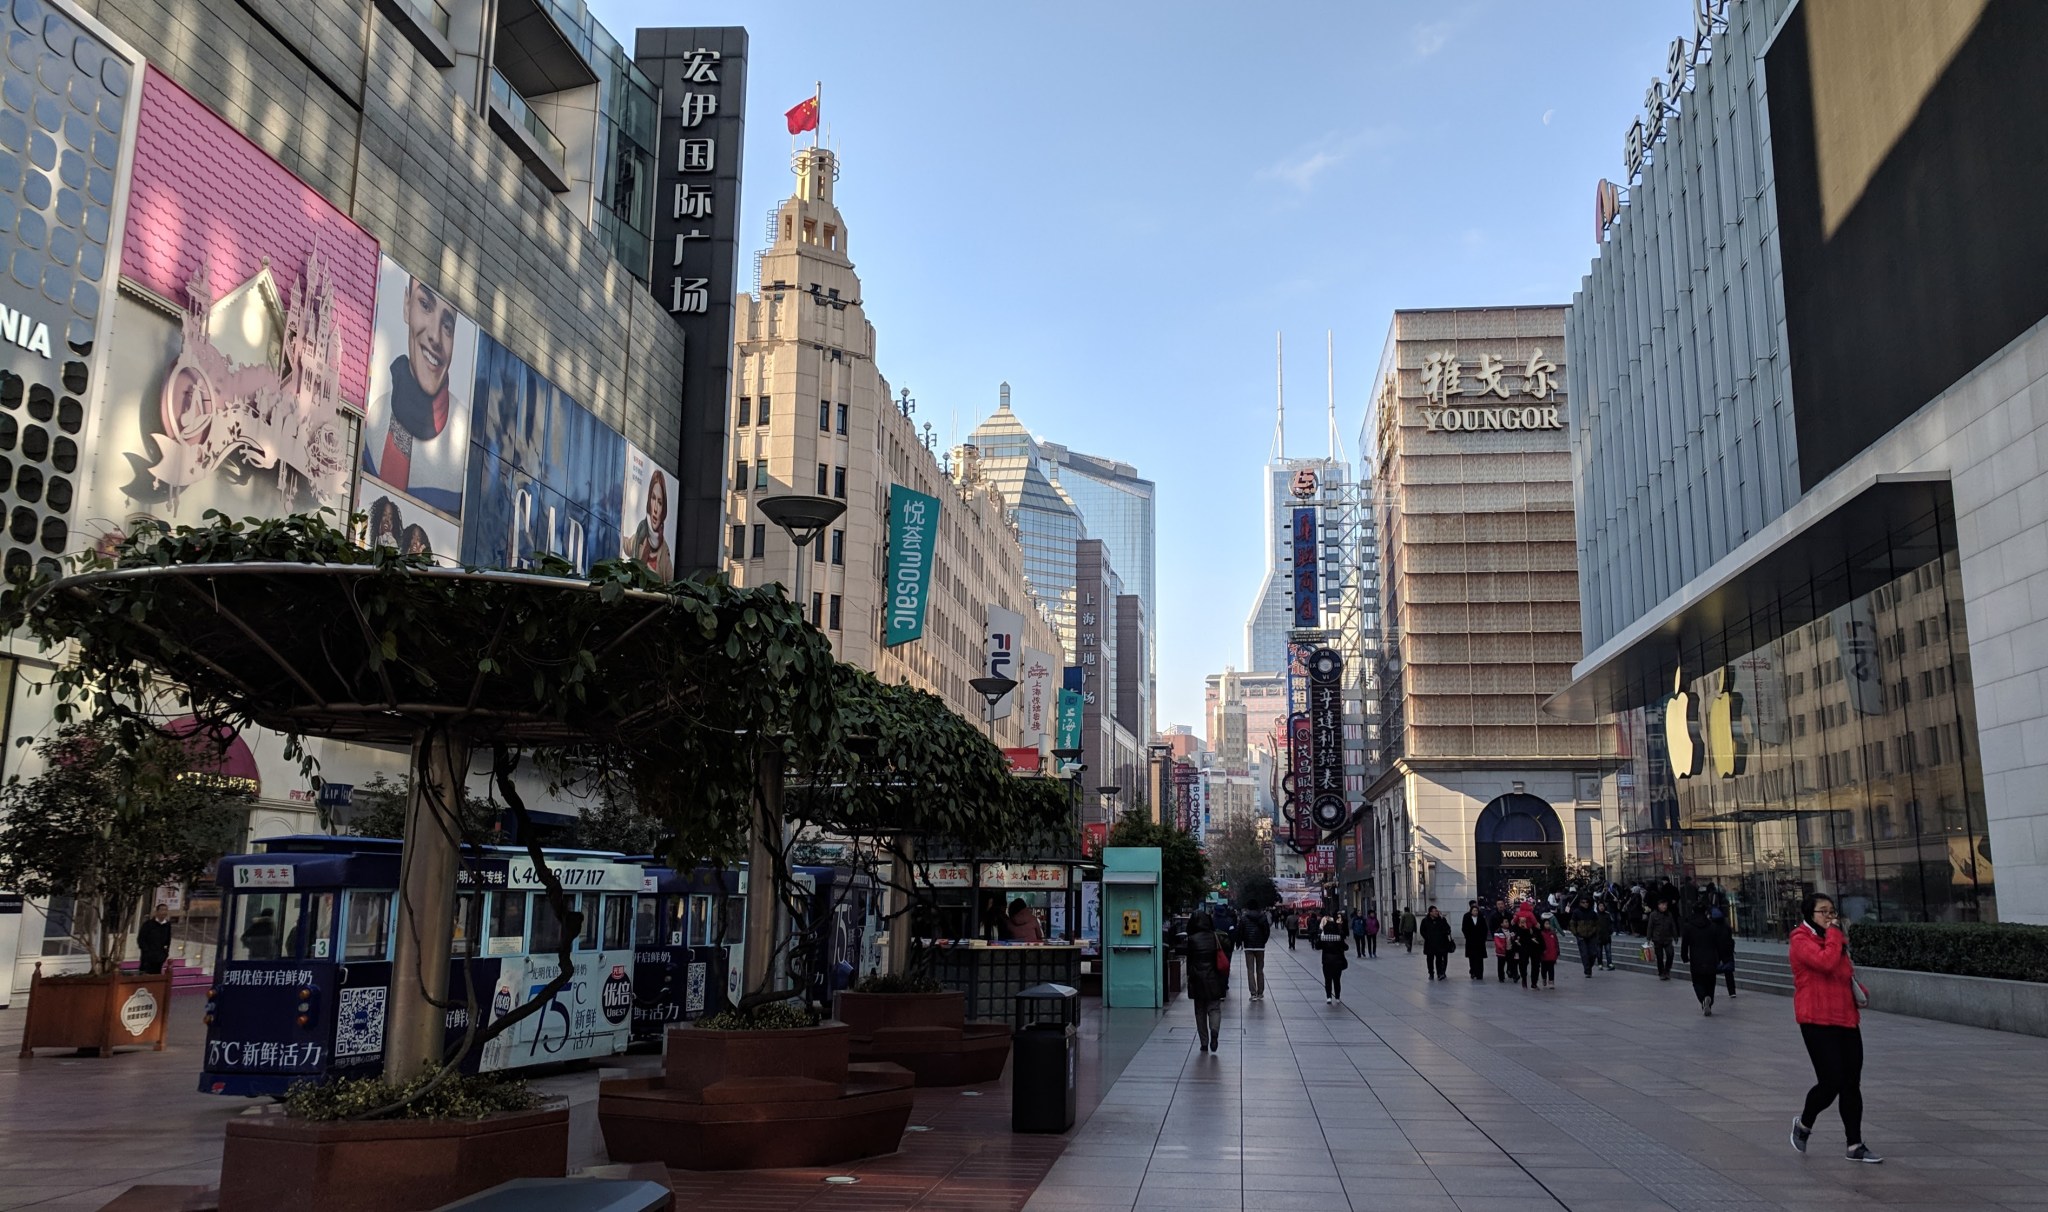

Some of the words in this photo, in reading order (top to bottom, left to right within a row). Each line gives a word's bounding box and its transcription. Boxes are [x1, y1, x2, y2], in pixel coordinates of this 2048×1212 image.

[670, 48, 720, 314] 宏伊国际广场
[1420, 347, 1559, 408] 雅戈尔
[1421, 406, 1564, 432] YOUNGOR
[1082, 592, 1097, 705] 上海置地广场
[1501, 850, 1538, 858] YOUNGOR
[254, 867, 289, 880] 观光车
[317, 941, 327, 955] 3
[673, 933, 681, 944] 3
[604, 981, 630, 1006] 优倍
[607, 1008, 626, 1017] UBEST
